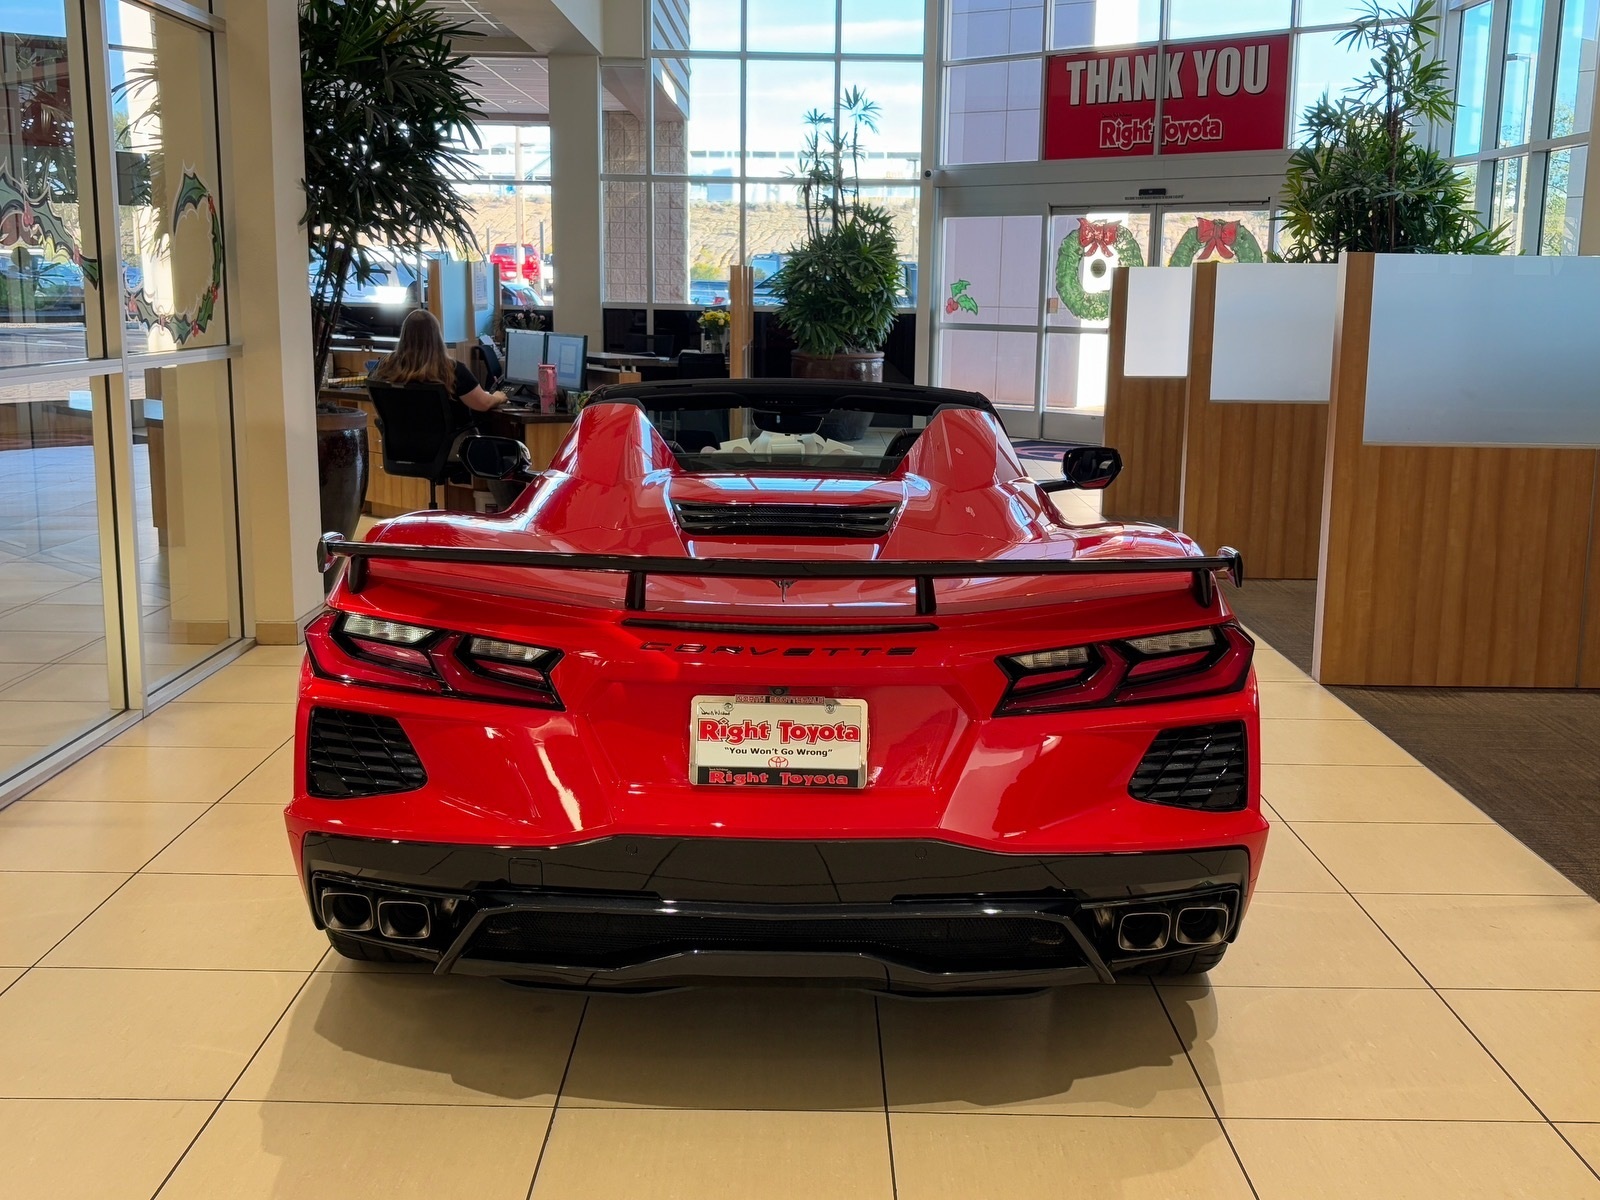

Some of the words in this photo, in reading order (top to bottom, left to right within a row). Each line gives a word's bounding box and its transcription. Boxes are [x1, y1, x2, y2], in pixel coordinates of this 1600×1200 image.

[1066, 51, 1184, 106] THANK
[1192, 44, 1270, 97] YOU
[1099, 118, 1154, 150] Right
[640, 641, 918, 657] CORVETTE
[698, 718, 771, 745] Right
[777, 720, 861, 745] Toyota
[724, 747, 747, 755] "You
[796, 749, 833, 757] Wrong"
[708, 771, 769, 785] Right
[779, 772, 849, 786] Toyota
